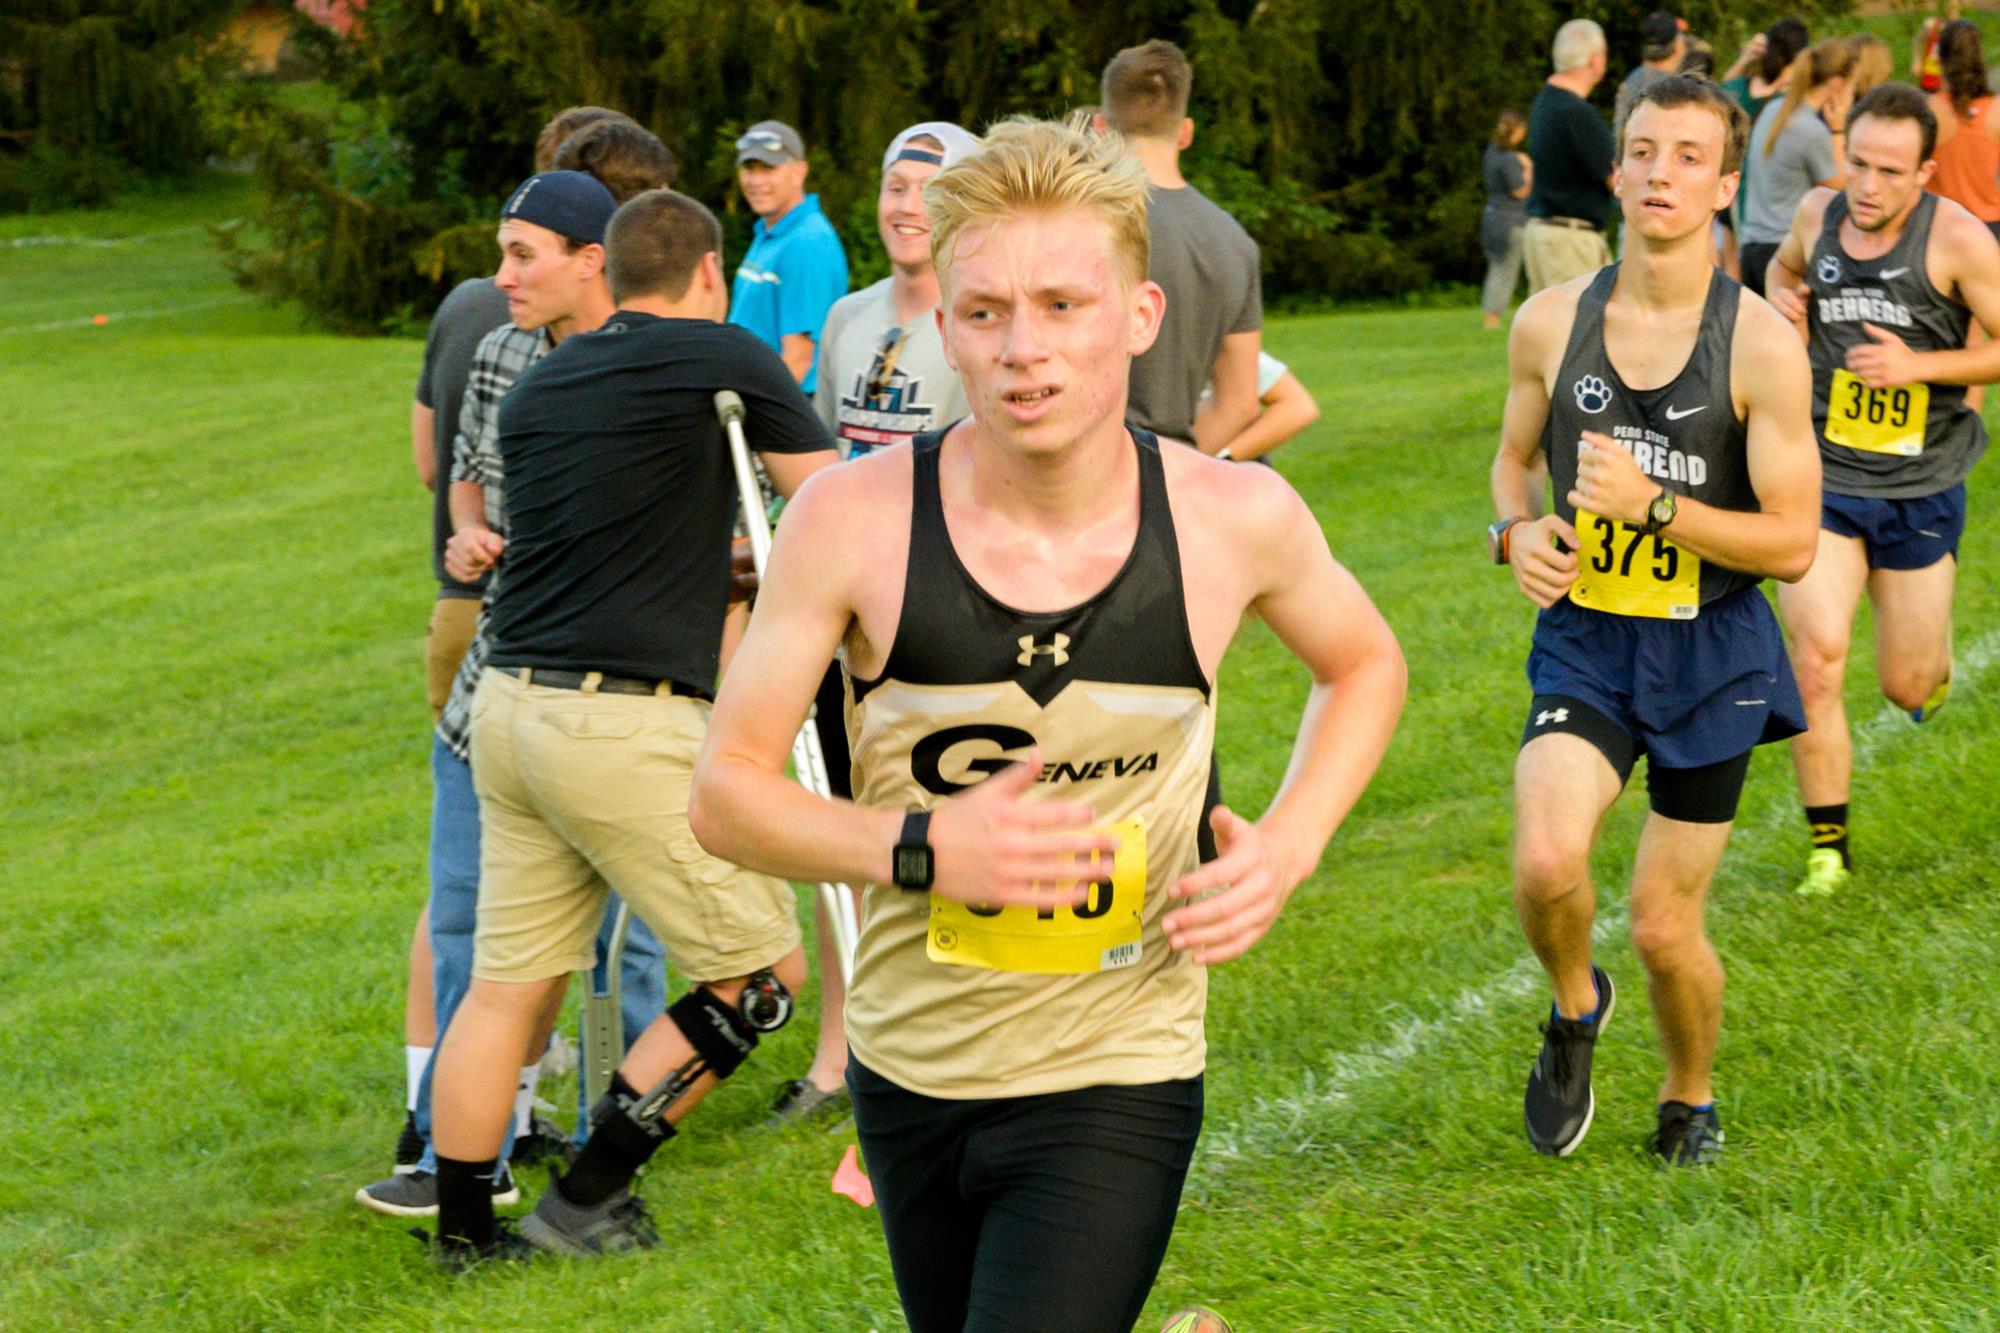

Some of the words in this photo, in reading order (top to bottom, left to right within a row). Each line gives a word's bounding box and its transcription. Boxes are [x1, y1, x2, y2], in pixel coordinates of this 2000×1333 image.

[1845, 381, 1910, 428] 369
[1578, 438, 1707, 486] REND
[1591, 516, 1679, 582] 375
